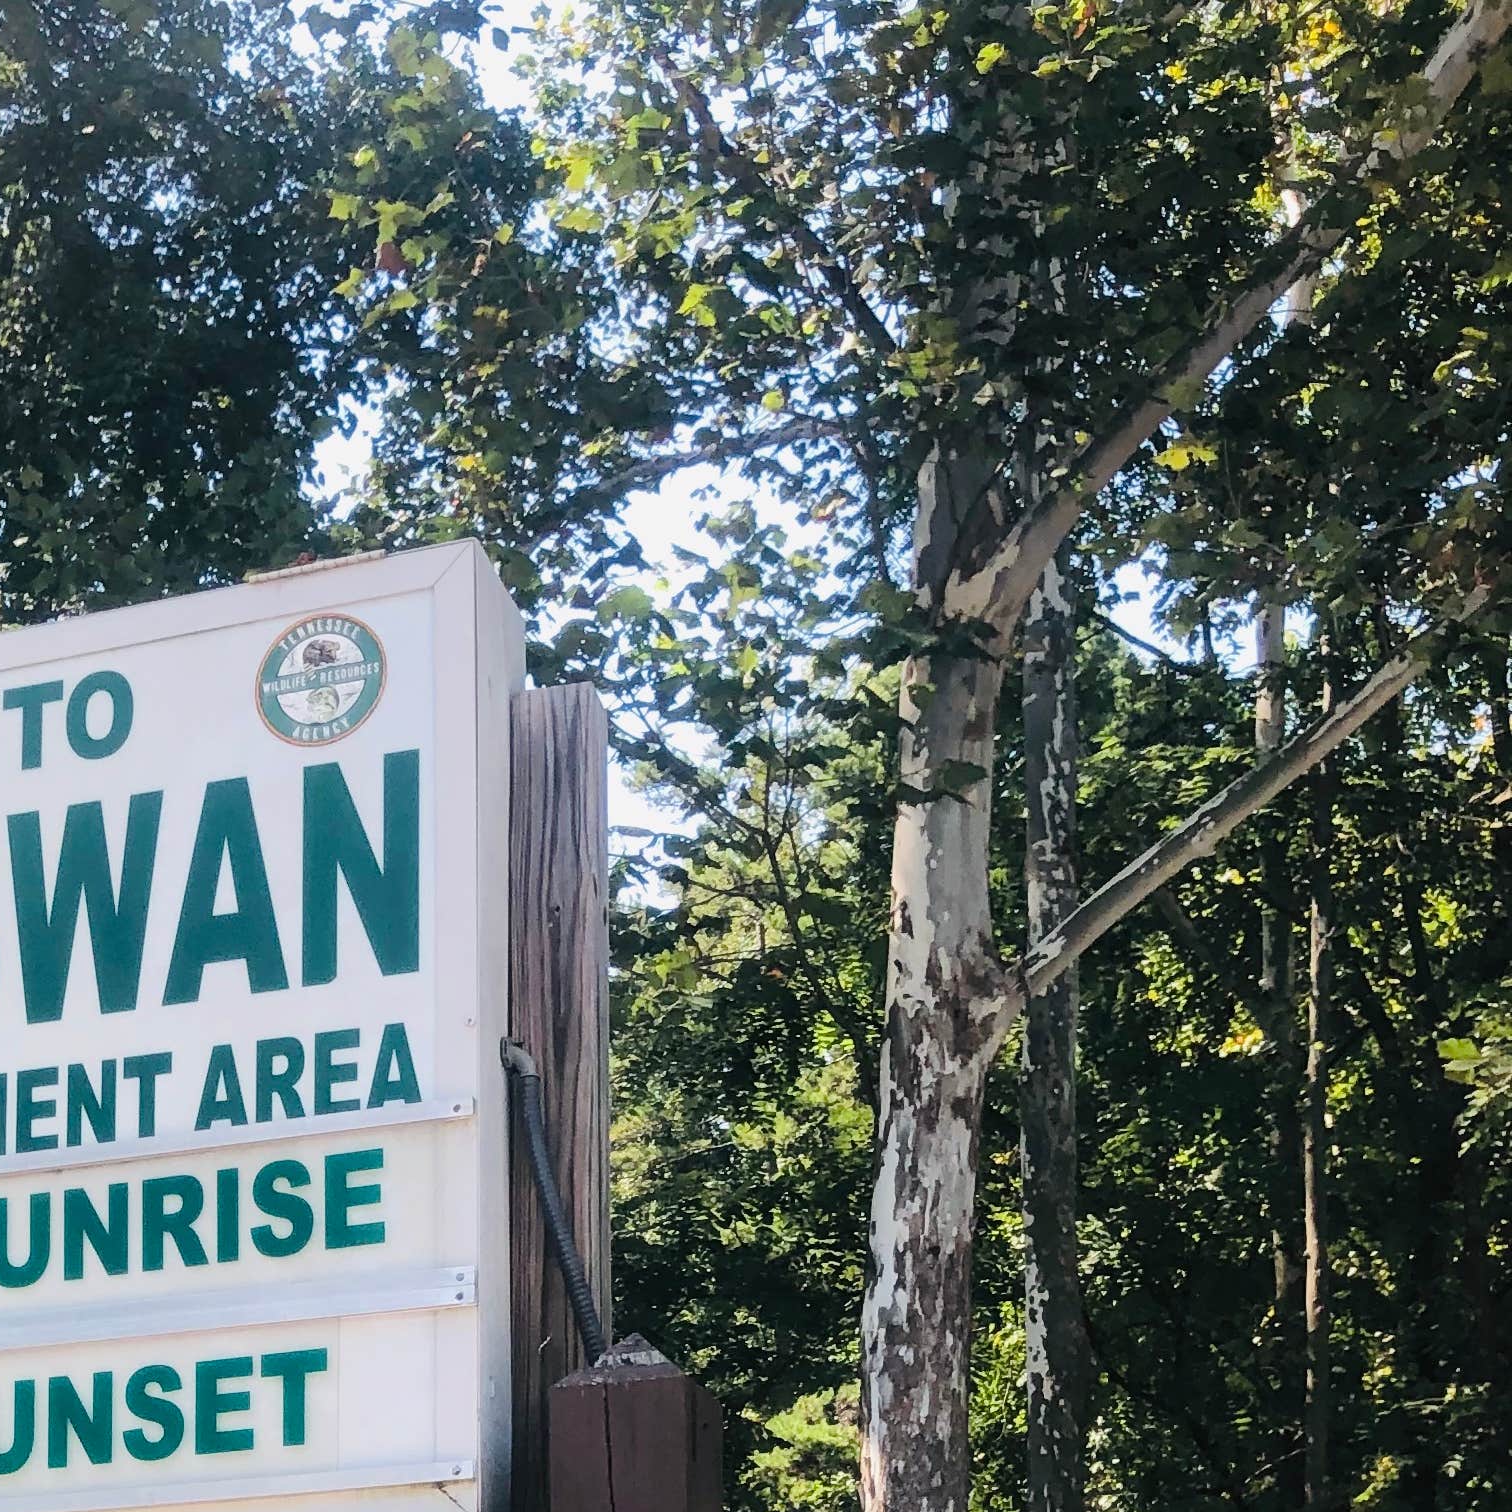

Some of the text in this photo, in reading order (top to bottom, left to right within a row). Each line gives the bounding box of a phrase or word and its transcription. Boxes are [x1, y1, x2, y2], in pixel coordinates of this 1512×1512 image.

[278, 618, 361, 650] TENNESSEE
[262, 661, 380, 693] WILDLIFE RESOURCES
[2, 670, 135, 770] TO
[291, 717, 350, 741] AGENCY
[194, 1021, 423, 1132] AREA
